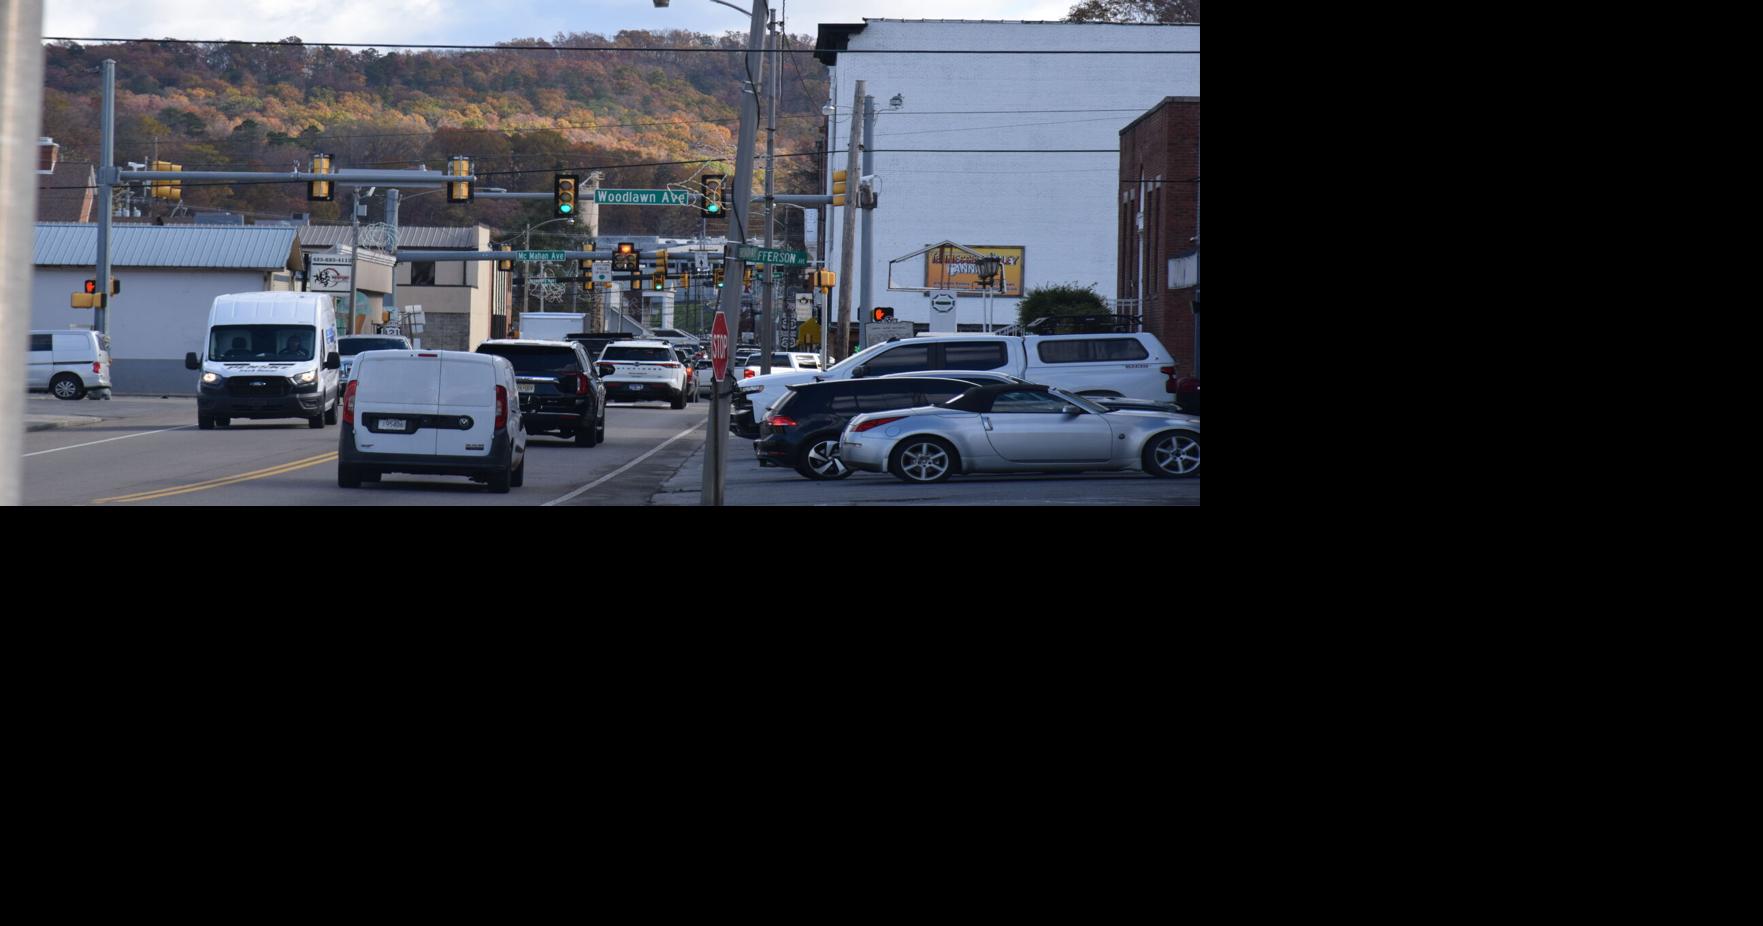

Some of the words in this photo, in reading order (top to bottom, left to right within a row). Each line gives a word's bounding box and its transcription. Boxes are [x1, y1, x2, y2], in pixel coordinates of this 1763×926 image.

[597, 190, 656, 203] Woodlawn
[661, 191, 685, 203] Ave
[551, 251, 564, 260] Ave
[749, 246, 796, 264] FFERSON
[713, 334, 727, 359] STOP
